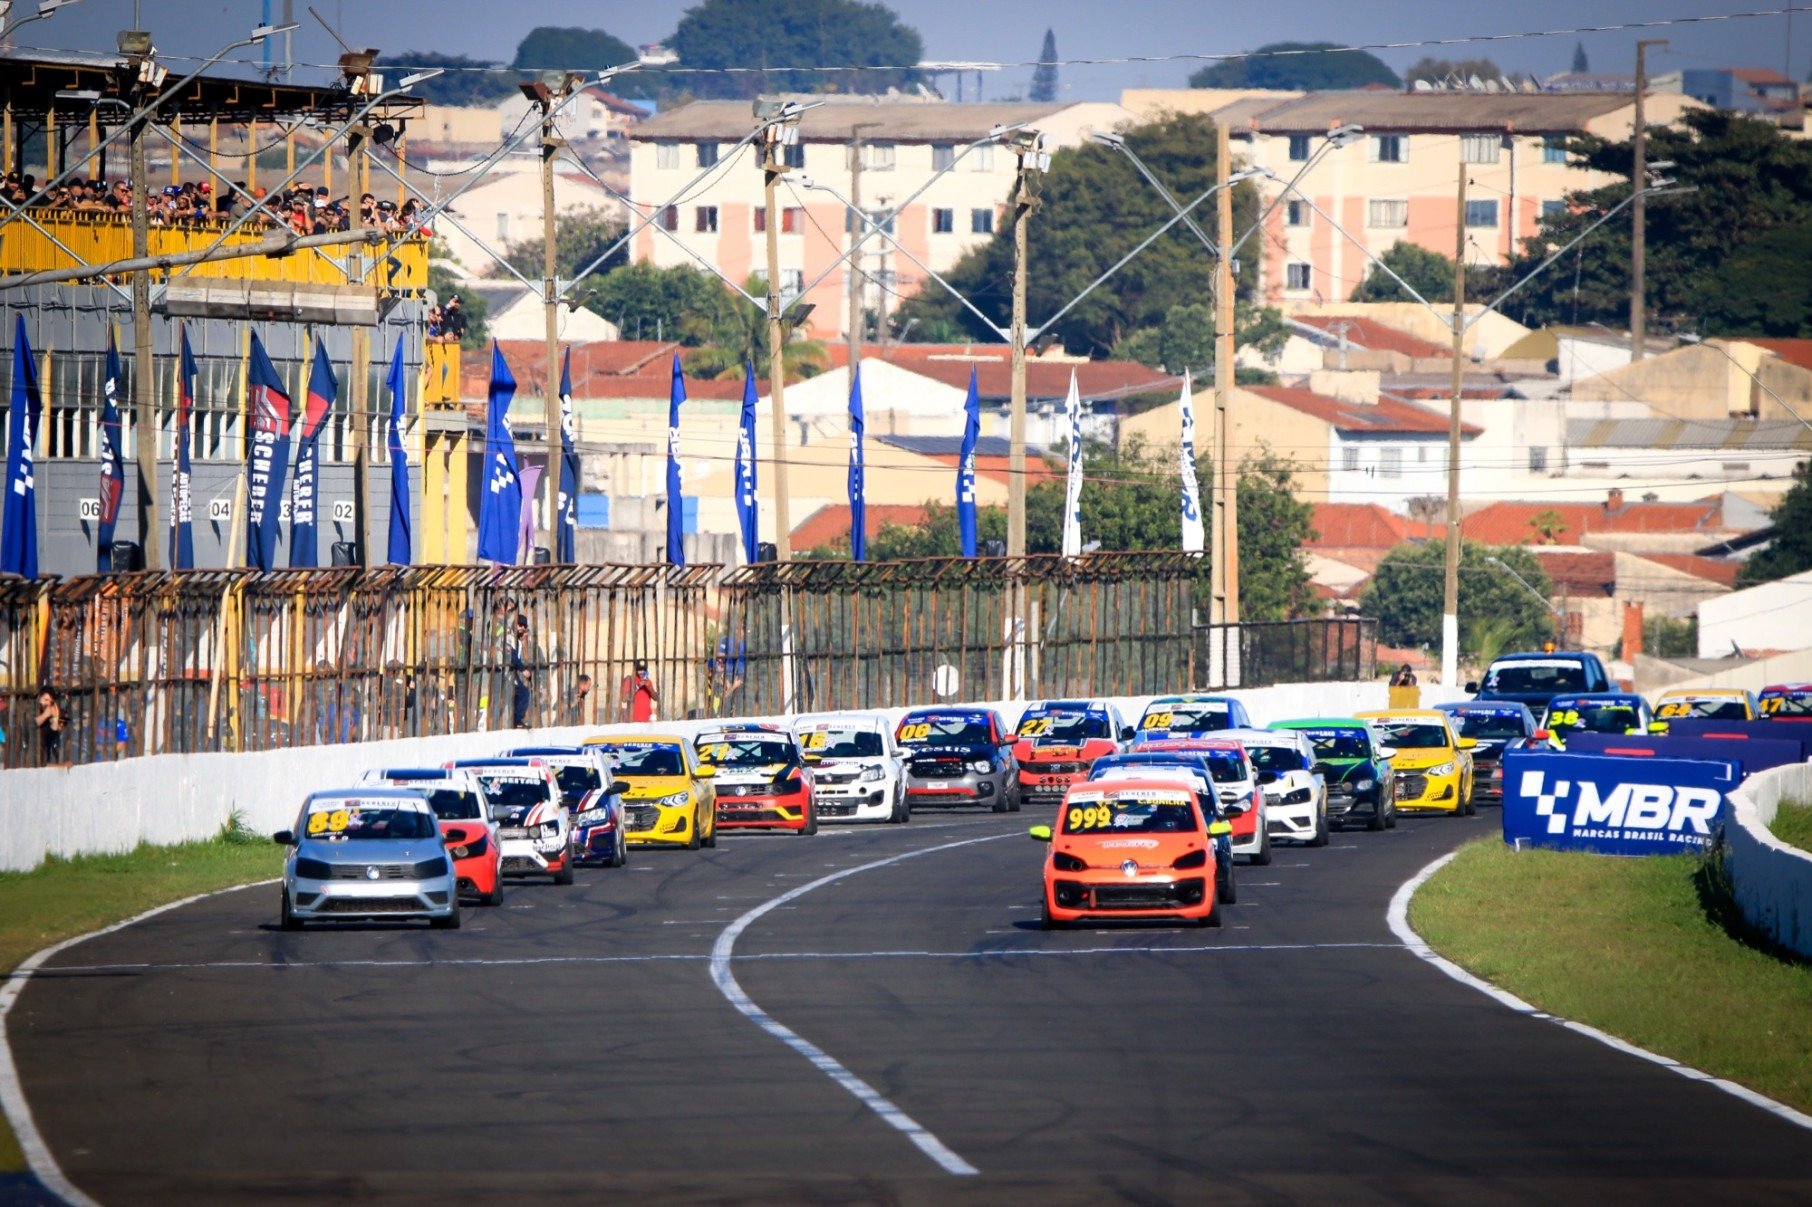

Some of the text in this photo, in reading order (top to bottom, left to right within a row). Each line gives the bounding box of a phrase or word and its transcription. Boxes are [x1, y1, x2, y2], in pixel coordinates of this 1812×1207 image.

[250, 430, 275, 526] SCHERER
[81, 501, 100, 517] 06
[211, 502, 230, 517] 04
[334, 504, 353, 519] 02
[1549, 710, 1579, 726] 38
[1659, 703, 1692, 718] 64
[1020, 719, 1052, 735] 27
[1143, 712, 1173, 729] 09
[900, 723, 932, 740] 06
[698, 743, 730, 761] 21
[1572, 781, 1722, 835] MBR
[308, 810, 349, 834] 89
[1069, 806, 1112, 831] 999
[1572, 829, 1620, 839] MARCAS
[1623, 831, 1665, 841] BRASIL
